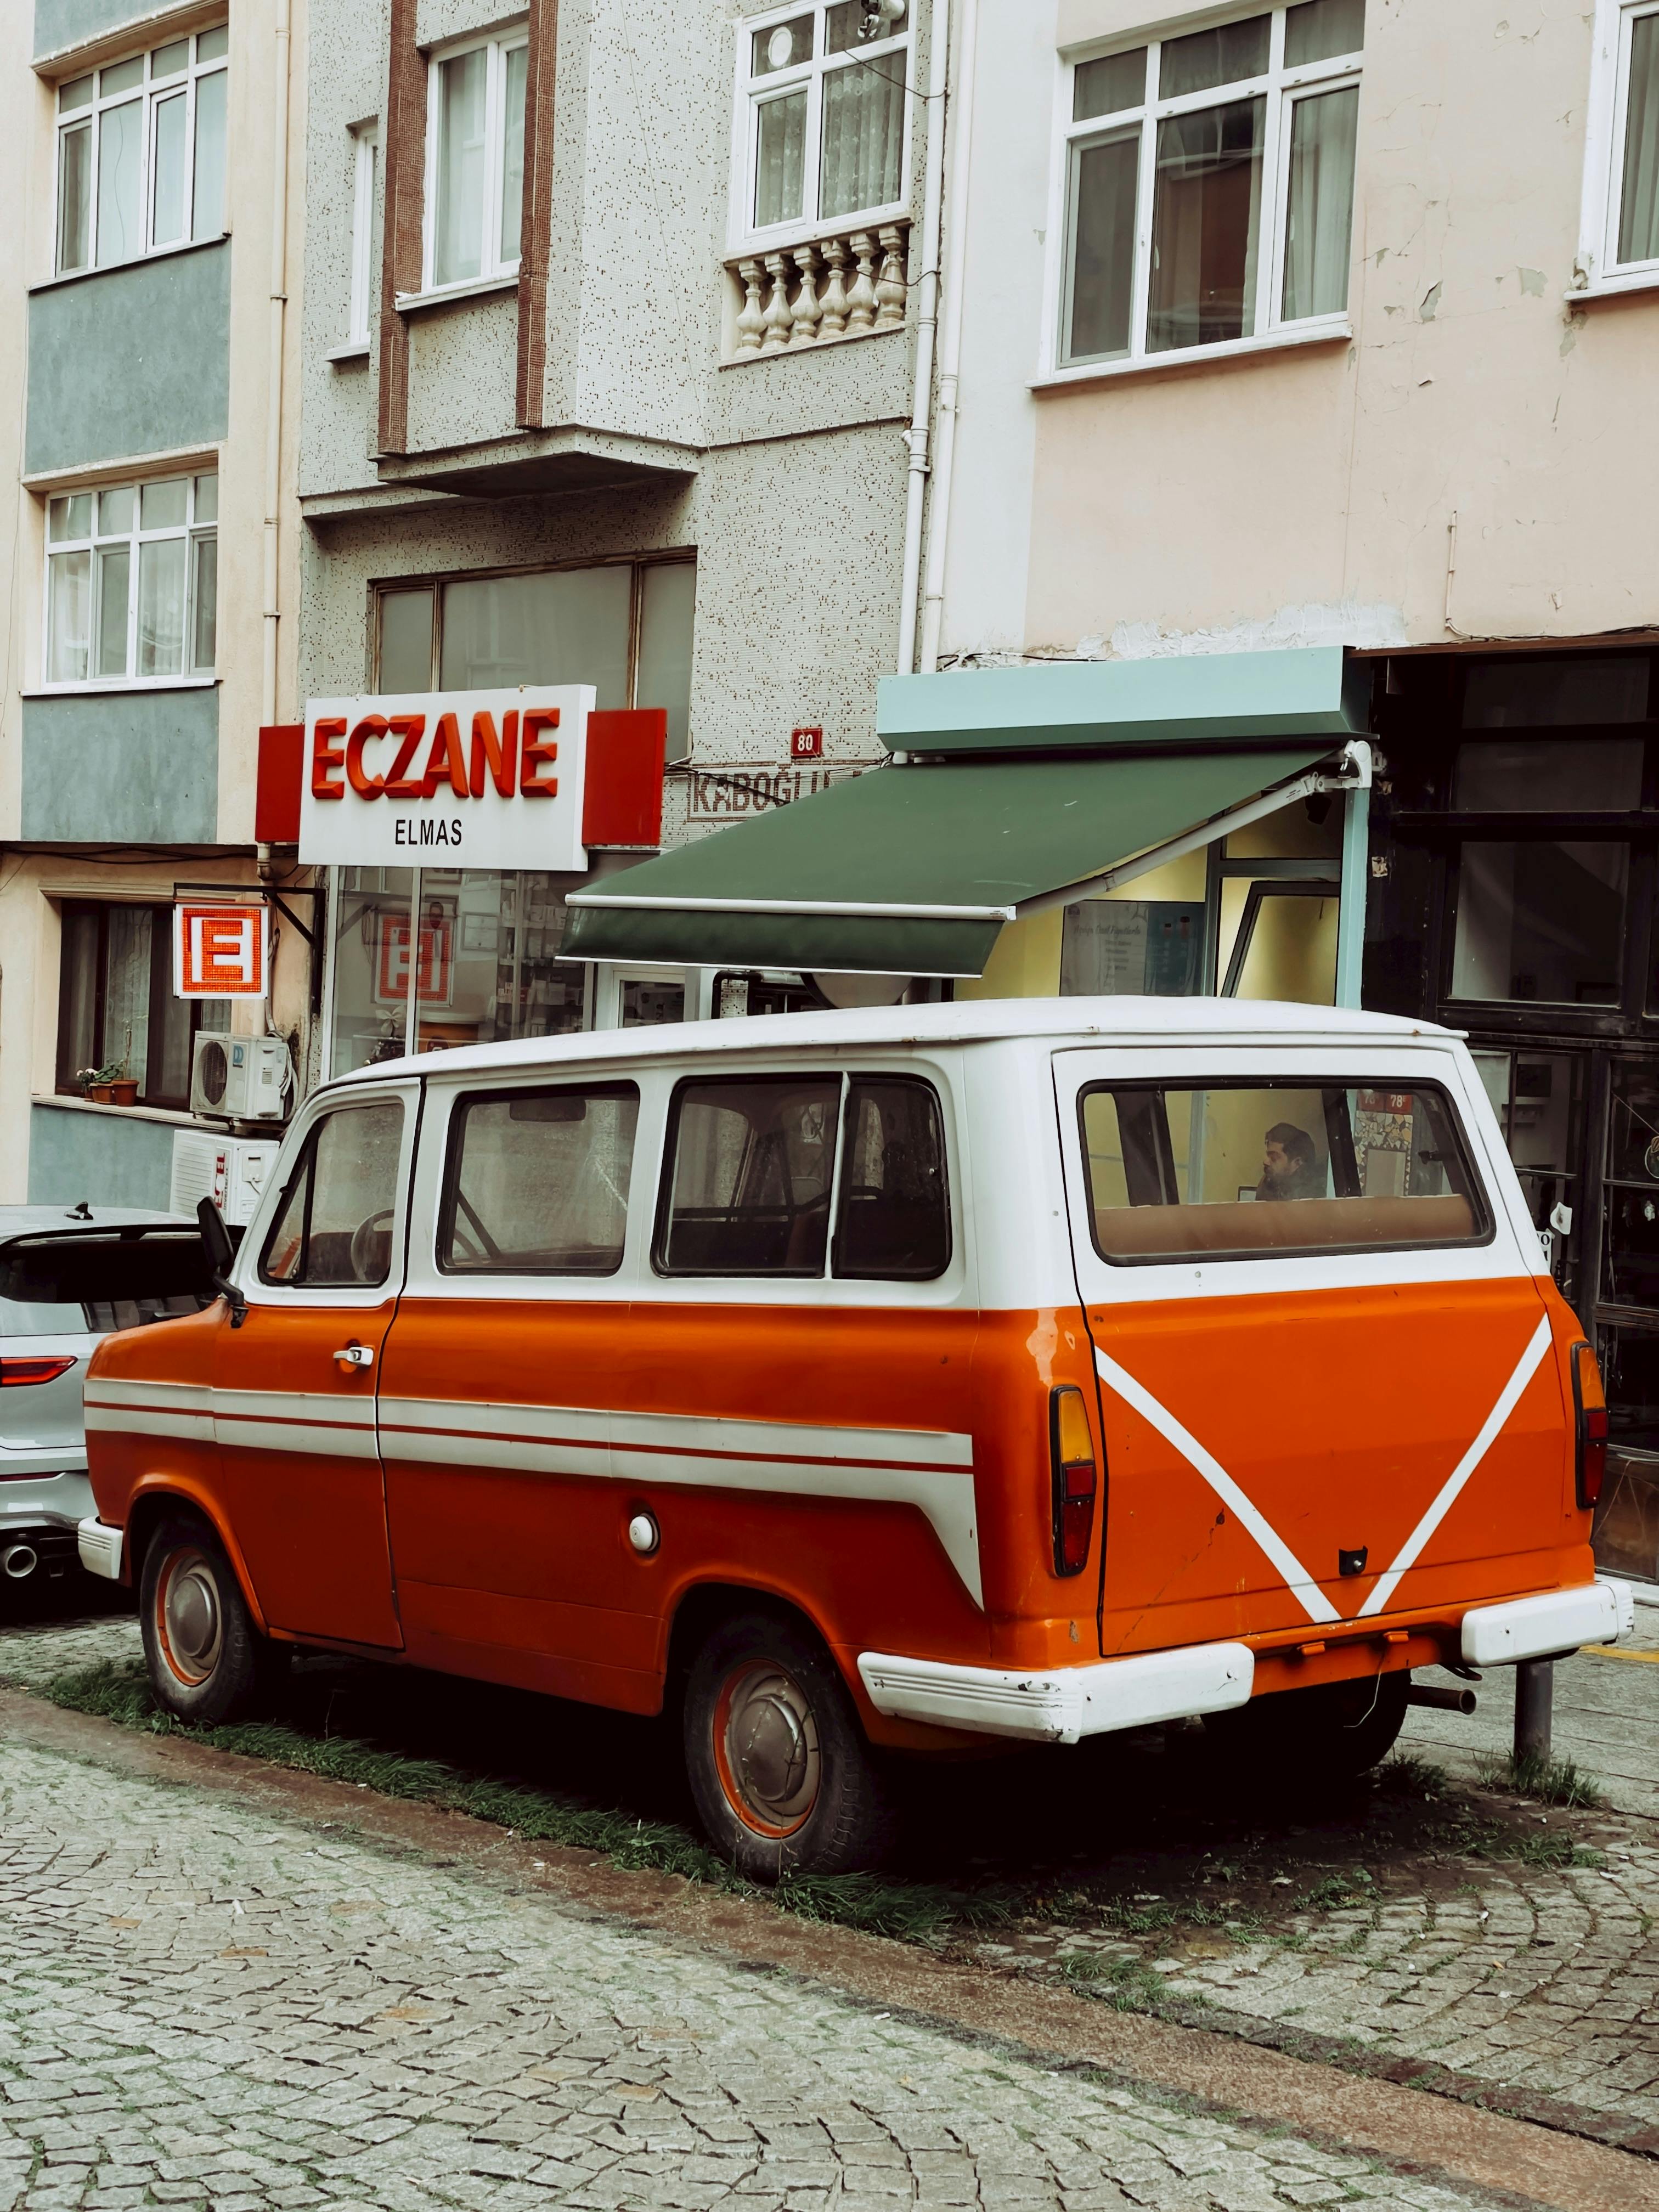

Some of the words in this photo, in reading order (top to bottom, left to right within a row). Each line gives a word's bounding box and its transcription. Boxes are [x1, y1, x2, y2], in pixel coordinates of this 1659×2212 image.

[312, 708, 560, 800] ECZANE
[798, 734, 813, 752] 80
[395, 819, 462, 845] ELMAS
[202, 920, 242, 980] E
